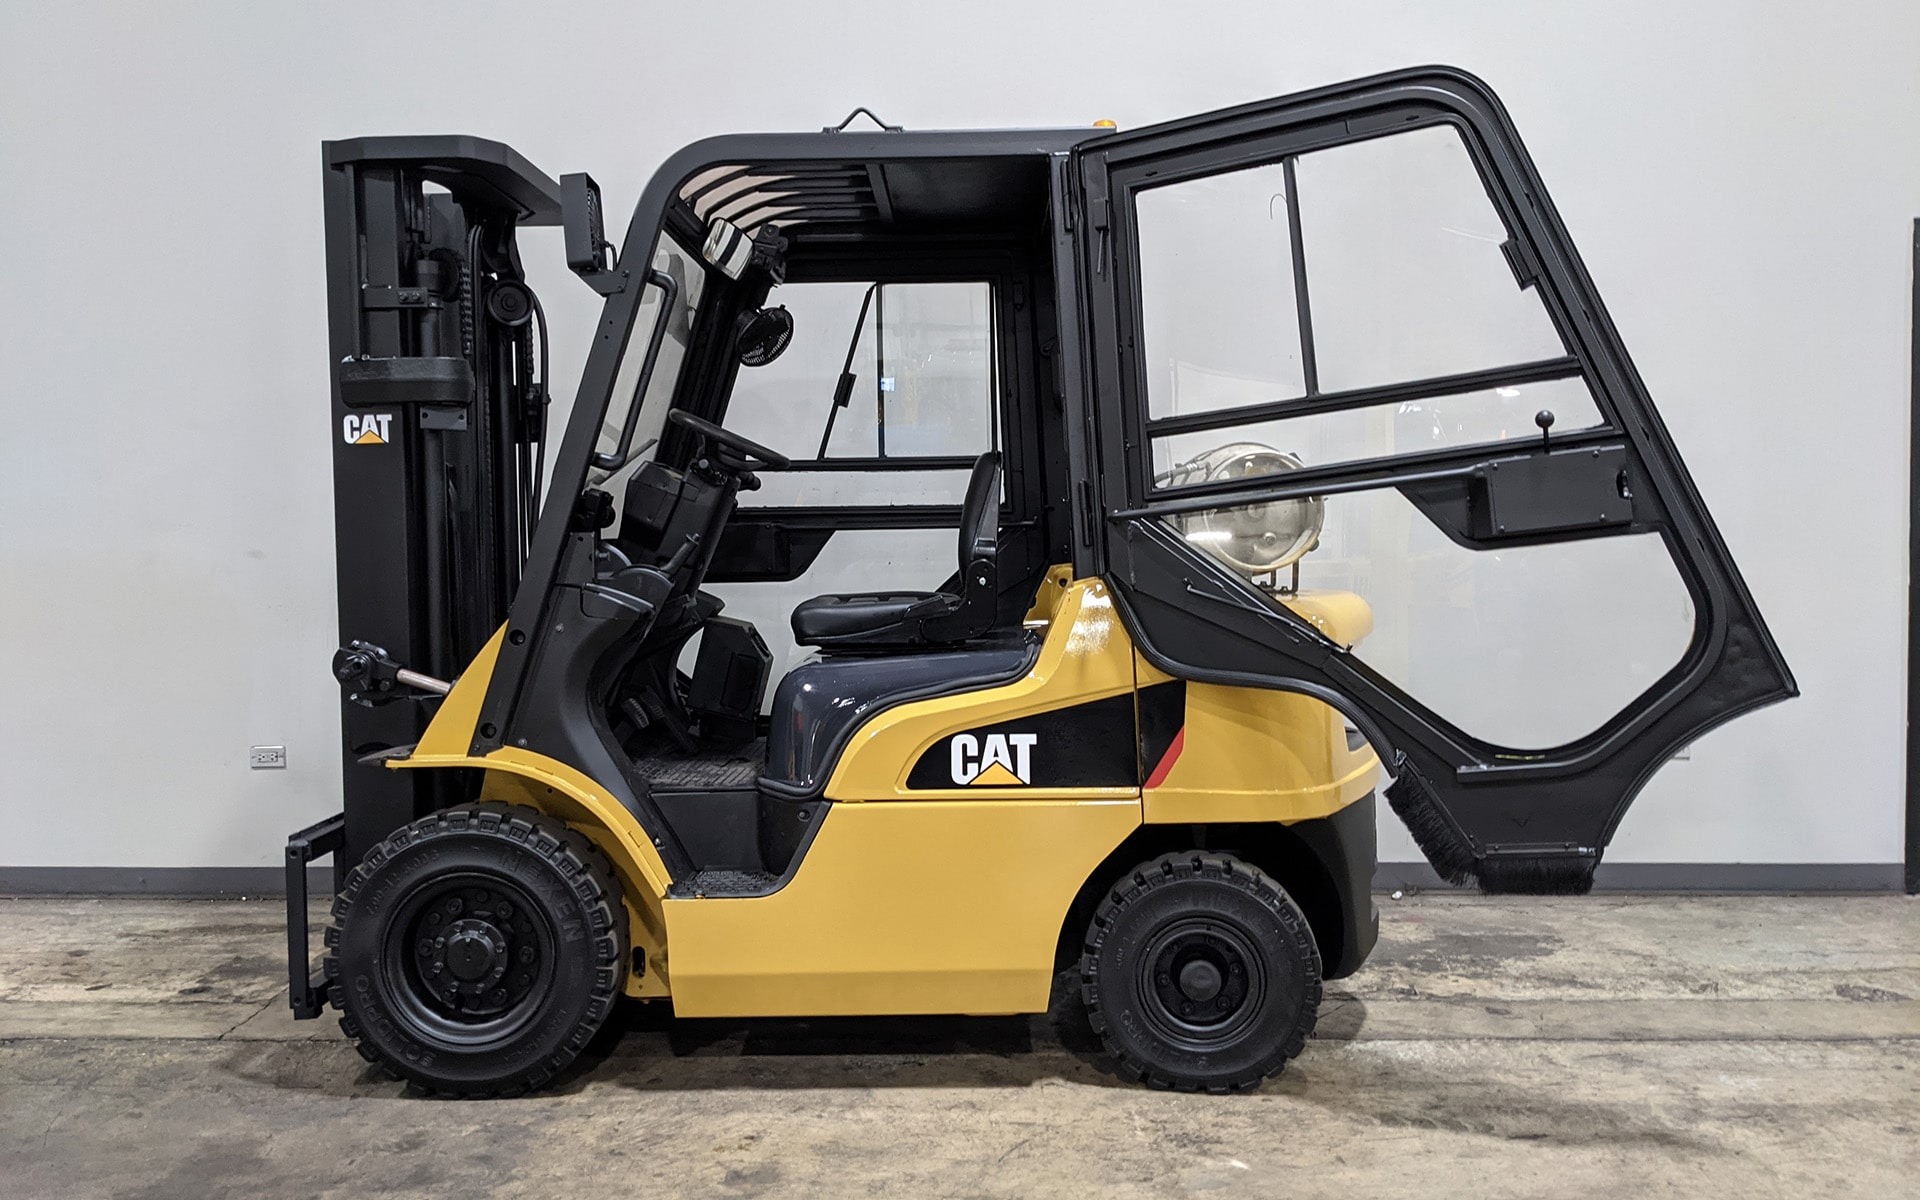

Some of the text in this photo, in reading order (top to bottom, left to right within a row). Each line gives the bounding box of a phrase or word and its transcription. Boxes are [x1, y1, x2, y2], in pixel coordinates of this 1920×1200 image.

[343, 414, 392, 444] CAT
[950, 733, 1037, 786] CAT
[499, 849, 583, 943] NEXEN
[355, 974, 436, 1068] SOLIDPRO
